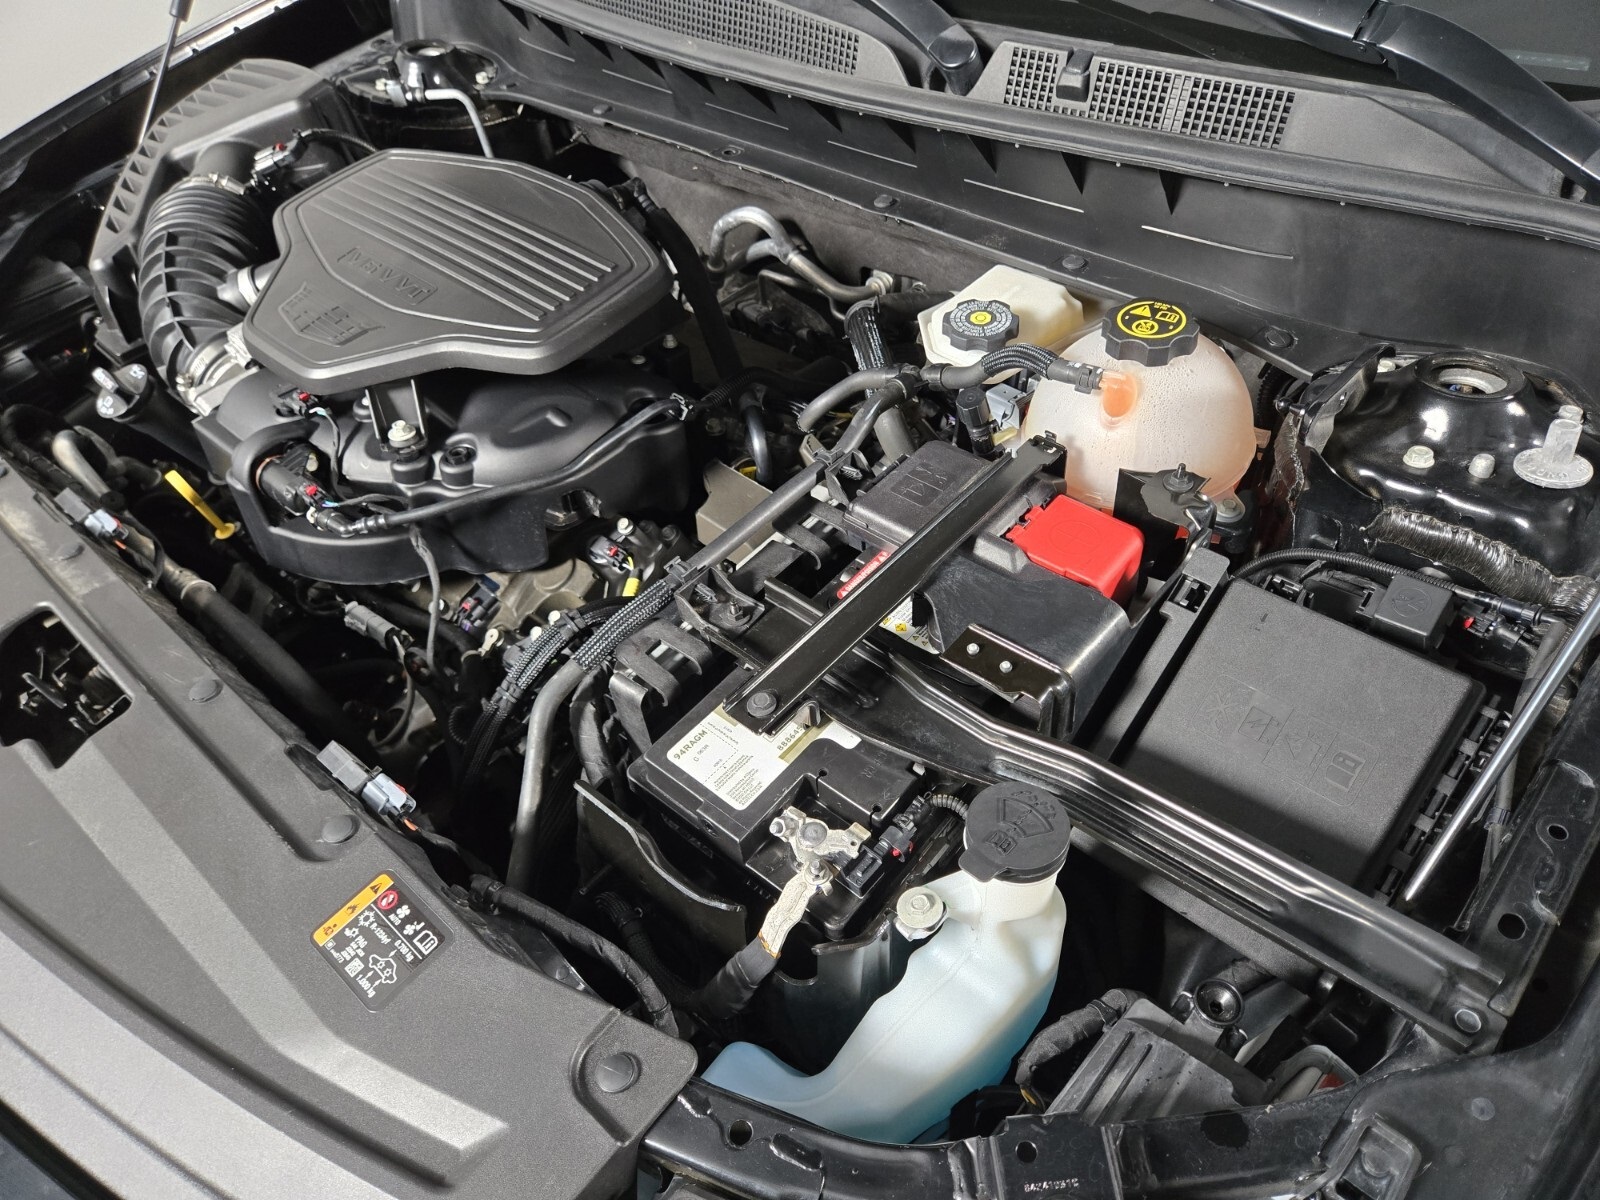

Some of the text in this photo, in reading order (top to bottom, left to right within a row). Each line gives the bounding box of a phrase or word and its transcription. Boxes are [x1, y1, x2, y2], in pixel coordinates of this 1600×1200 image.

[673, 729, 708, 760] 94RAGM
[776, 722, 805, 751] 888645
[388, 913, 402, 926] AUTO
[354, 935, 368, 949] PAG
[370, 922, 392, 945] R-1234yf
[355, 974, 371, 990] 1.000
